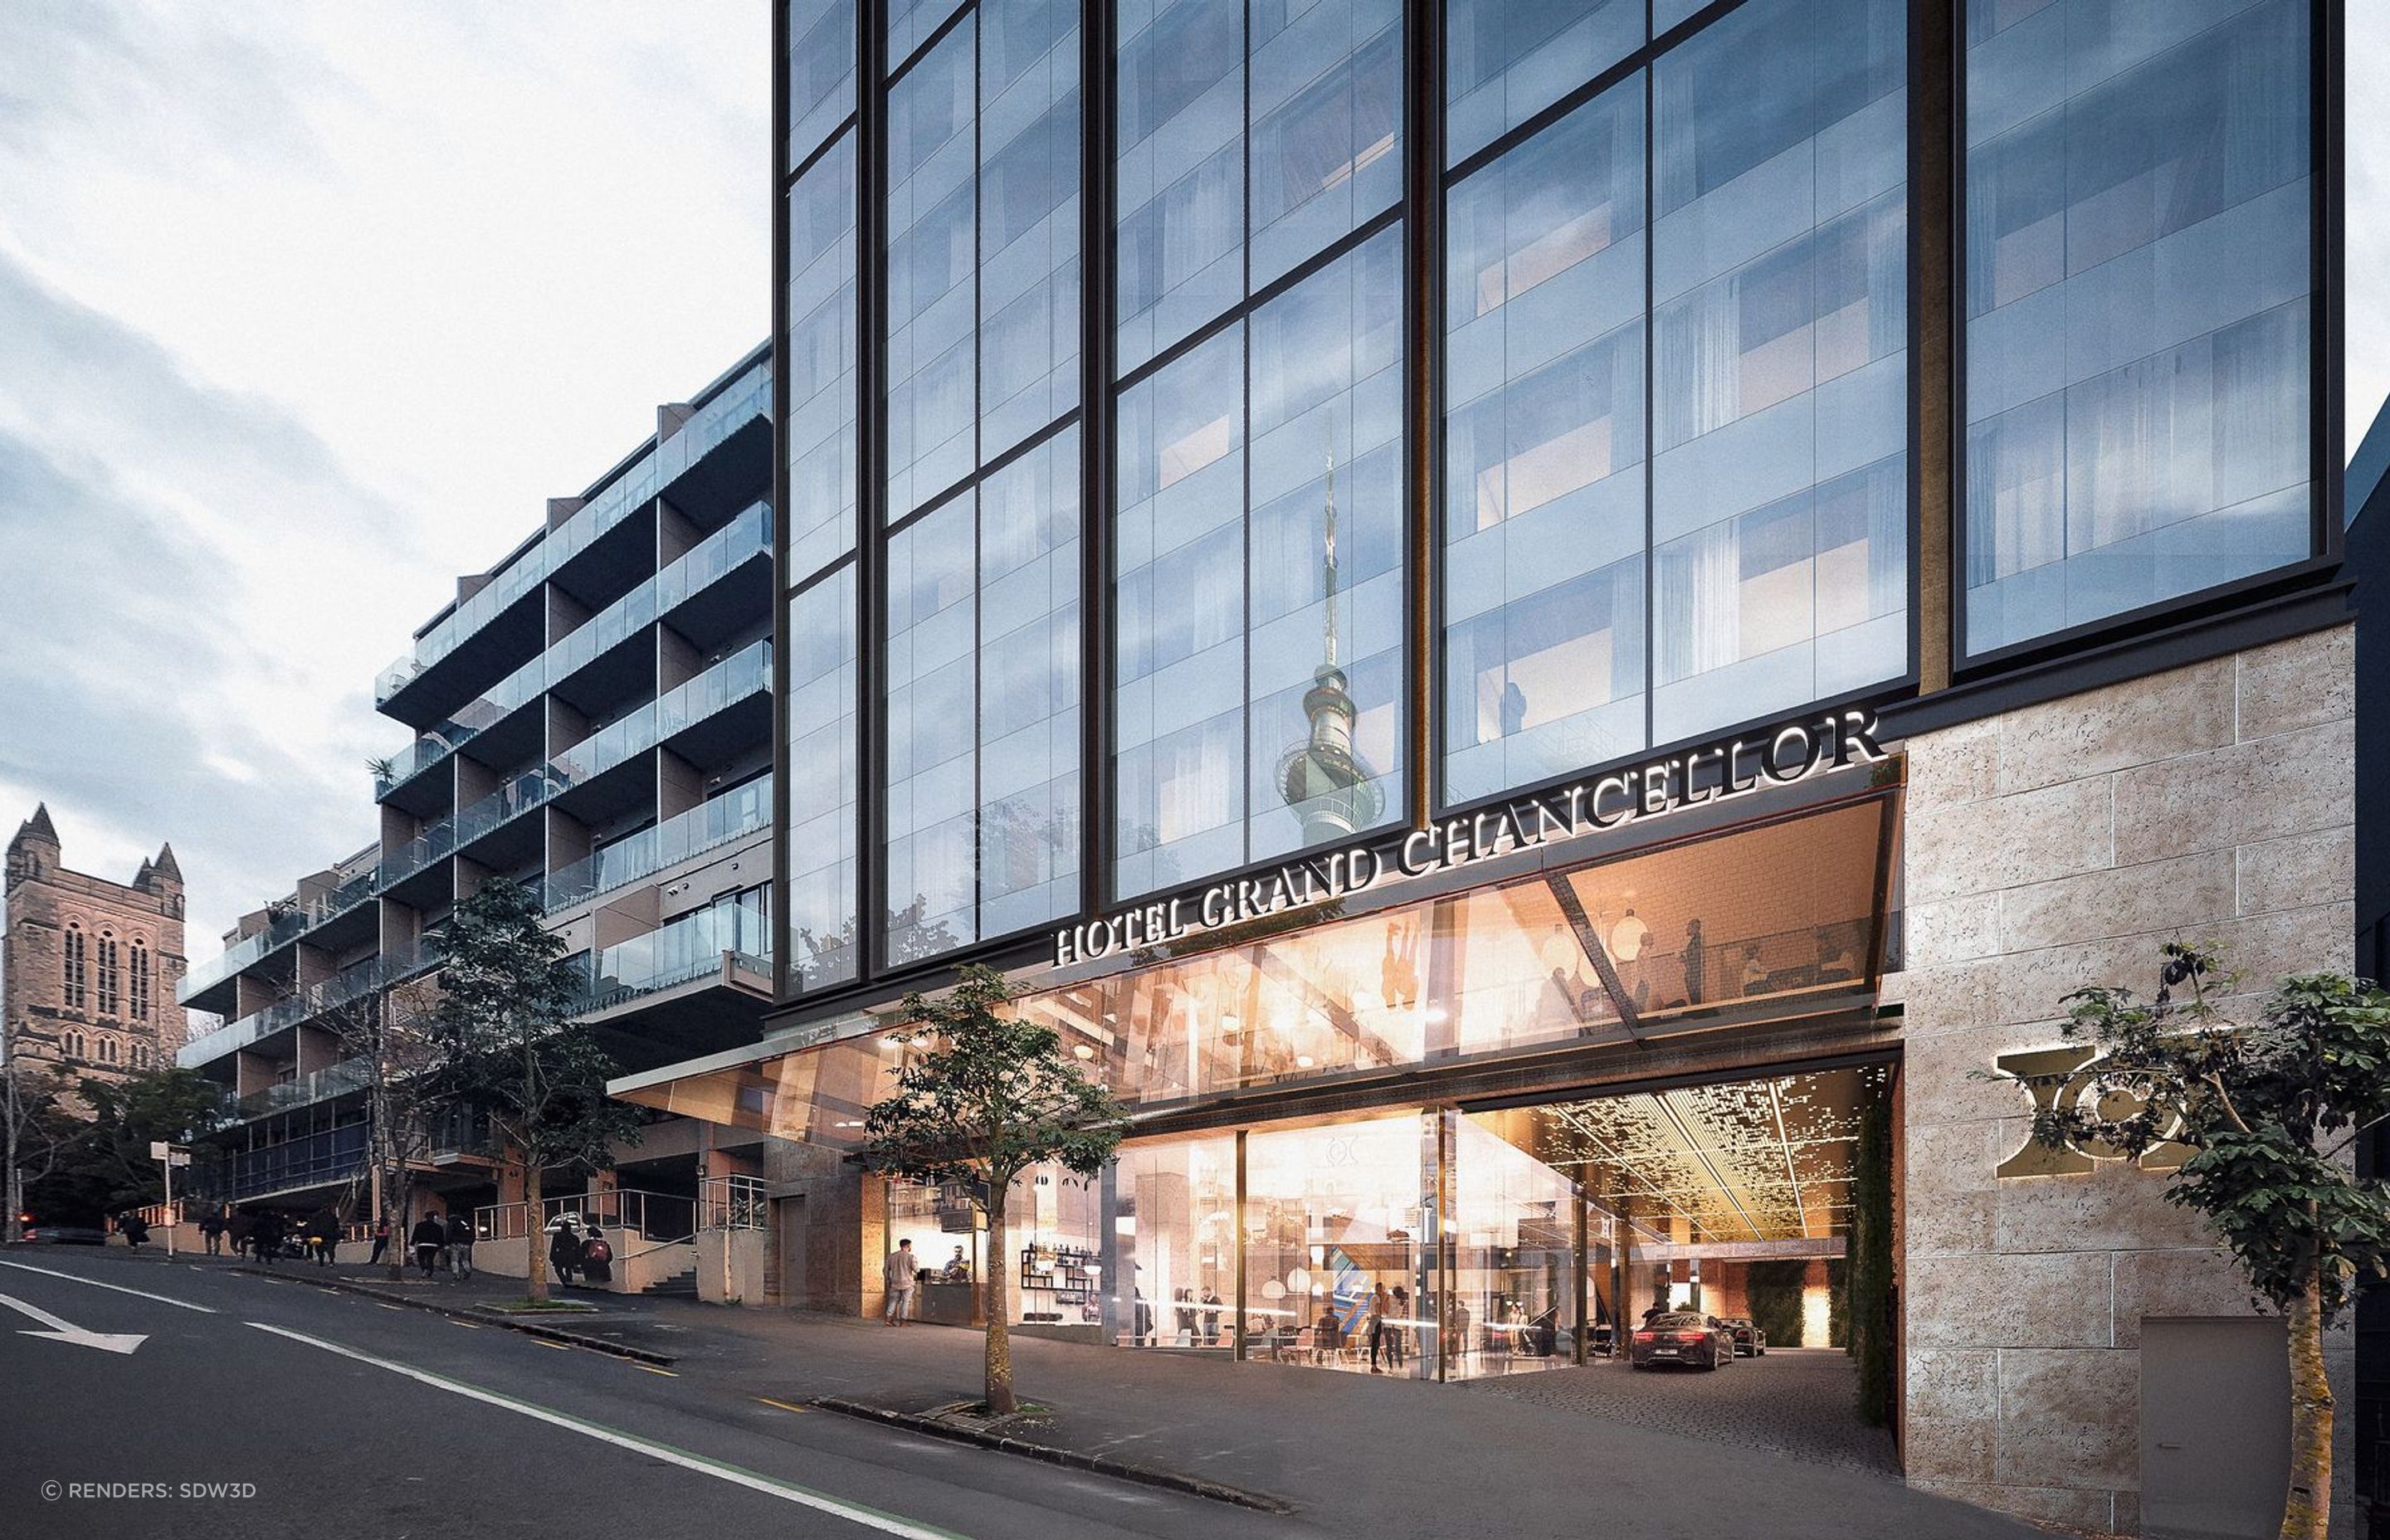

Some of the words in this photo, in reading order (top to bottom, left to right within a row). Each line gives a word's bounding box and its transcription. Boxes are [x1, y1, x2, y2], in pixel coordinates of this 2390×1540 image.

[1050, 897, 1187, 969] HOTEL
[1197, 847, 1383, 930] GRAND
[1396, 707, 1890, 878] CHANCELLOR
